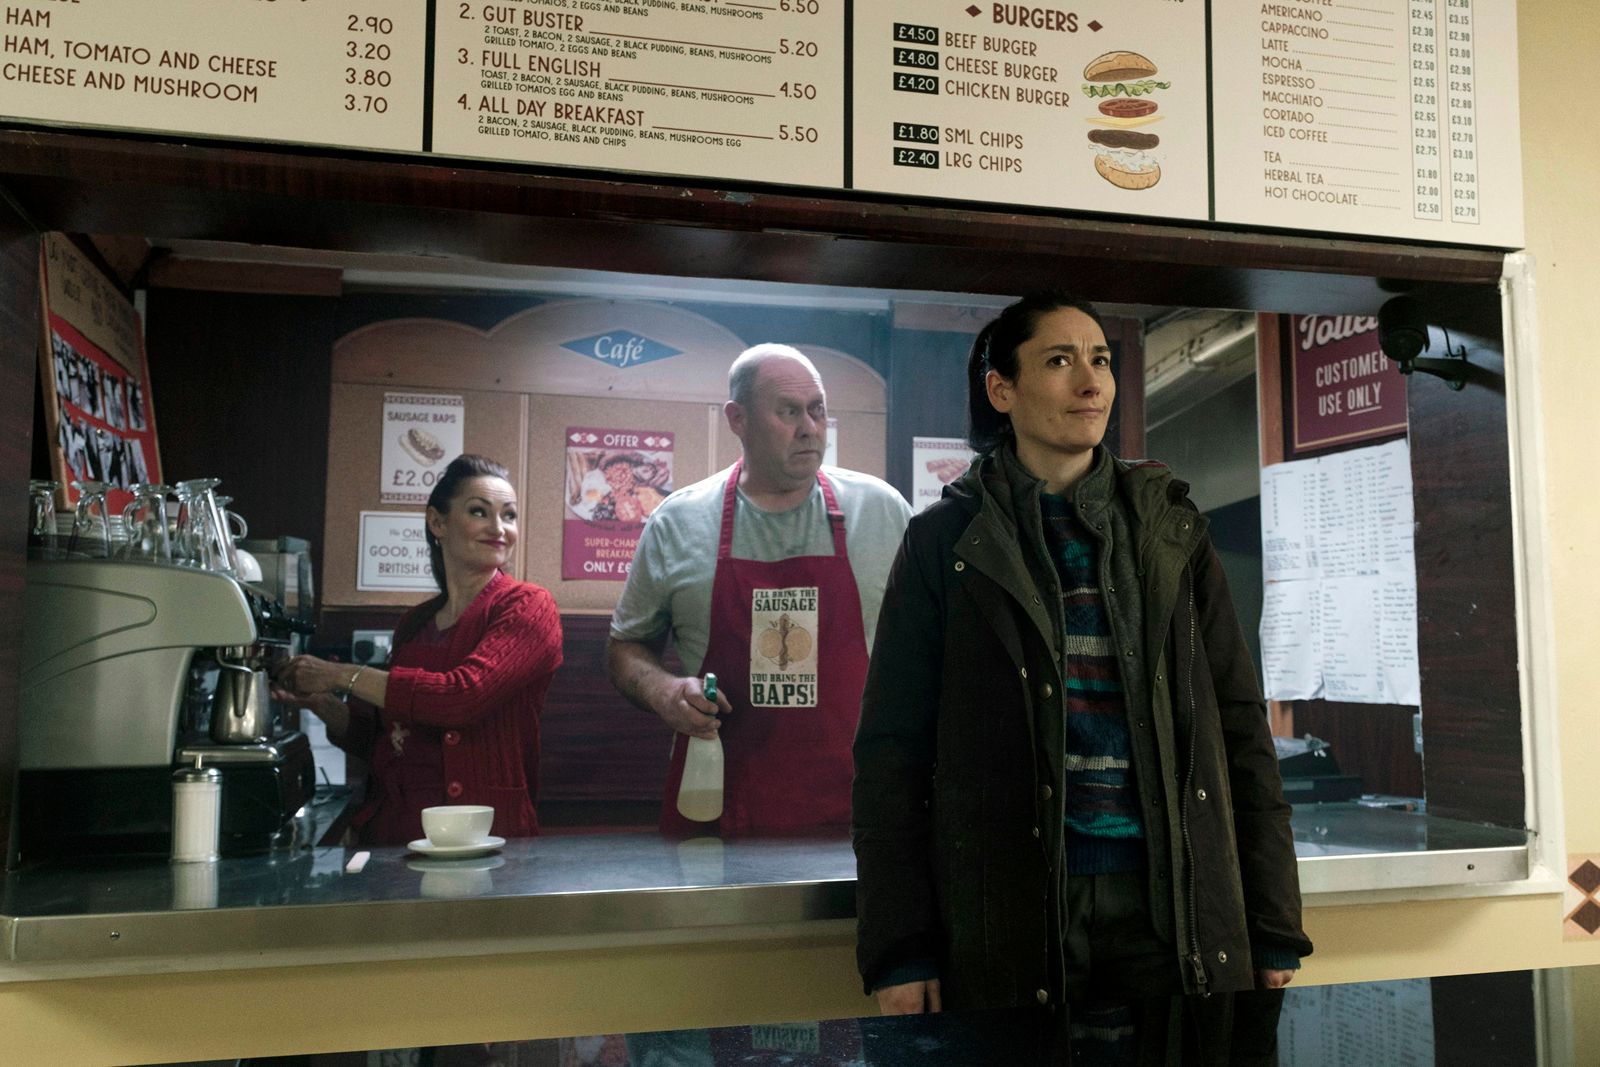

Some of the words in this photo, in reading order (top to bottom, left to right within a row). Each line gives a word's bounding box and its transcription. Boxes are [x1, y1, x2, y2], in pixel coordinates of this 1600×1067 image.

[572, 1, 577, 9] 2
[581, 3, 601, 12] EGGS
[604, 5, 621, 14] AND
[623, 7, 649, 17] BEANS
[681, 2, 708, 14] BEANS,
[710, 7, 763, 20] MUSHROOMS
[780, 0, 819, 15] 6.50
[1261, 4, 1323, 22] AMERICANO
[6, 7, 51, 28] HAM
[347, 14, 393, 35] 2.90
[460, 3, 475, 20] 2.
[483, 5, 516, 24] GUT
[523, 10, 583, 32] BUSTER
[992, 3, 1079, 33] BURGERS
[1261, 21, 1329, 39] CAPPACCINO
[484, 25, 490, 34] 2
[492, 26, 521, 37] TOAST,
[524, 30, 529, 38] 2
[532, 31, 564, 42] BACON,
[567, 35, 573, 43] 2
[575, 35, 613, 47] SAUSAGE,
[615, 40, 621, 48] 2
[623, 40, 648, 50] BLACK
[651, 43, 687, 56] PUDDING,
[690, 48, 717, 59] BEANS,
[719, 51, 772, 64] MUSHROOMS
[484, 36, 516, 46] GRILLED
[518, 39, 557, 52] TOMATO,
[559, 44, 565, 52] 2
[567, 44, 589, 54] EGGS
[591, 46, 609, 56] AND
[611, 49, 637, 59] BEANS
[779, 39, 818, 57] 5.20
[898, 26, 936, 42] £4.50
[945, 32, 977, 50] BEEF
[983, 36, 1038, 57] BURGER
[1262, 39, 1289, 52] LATTE
[4, 35, 55, 59] HAM,
[64, 40, 150, 65] TOMATO
[159, 51, 200, 70] AND
[208, 56, 278, 78] CHEESE
[346, 41, 391, 61] 3.20
[458, 48, 474, 65] 3.
[482, 50, 521, 70] FULL
[529, 55, 601, 78] ENGLISH
[898, 50, 937, 67] £4.80
[945, 55, 999, 76] CHEESE
[1004, 62, 1059, 83] BURGER
[1262, 56, 1302, 70] MOCHA
[3, 63, 76, 87] CHEESE
[84, 71, 125, 90] AND
[134, 76, 258, 103] MUSHROOM
[345, 68, 392, 88] 3.80
[1263, 73, 1315, 89] ESPRESSO
[481, 70, 510, 81] TOAST,
[512, 73, 518, 82] 2
[521, 74, 553, 86] BACON,
[556, 78, 561, 86] 2
[564, 79, 602, 91] SAUSAGE,
[604, 82, 630, 92] BLACK
[632, 85, 668, 97] PUDDING,
[671, 89, 699, 101] BEANS,
[701, 92, 754, 105] MUSHROOMS
[481, 80, 513, 91] GRILLED
[515, 83, 557, 96] TOMATOS
[559, 88, 575, 97] EGG
[578, 90, 595, 100] AND
[597, 92, 624, 102] BEANS
[779, 82, 817, 100] 4.50
[898, 75, 936, 92] £4.20
[945, 80, 1010, 101] CHICKEN
[1016, 87, 1070, 108] BURGER
[344, 94, 388, 114] 3.70
[1263, 91, 1323, 107] MACCHIATO
[1414, 94, 1436, 105] £2.20
[457, 93, 472, 111] 4.
[478, 95, 510, 115] ALL
[517, 99, 547, 118] DAY
[554, 102, 645, 127] BREAKFAST
[1263, 108, 1314, 123] CORTADO
[478, 115, 483, 124] 2
[486, 116, 520, 128] BACON,
[523, 120, 528, 128] 2
[530, 120, 569, 133] SAUSAGE,
[572, 124, 597, 134] BLACK
[600, 127, 637, 139] PUDDING,
[639, 131, 667, 142] BEANS,
[670, 133, 724, 146] MUSHROOMS
[726, 138, 742, 147] EGG
[478, 126, 510, 137] GRILLED
[513, 129, 552, 141] TOMATO,
[554, 133, 581, 143] BEANS
[583, 135, 600, 145] AND
[603, 137, 627, 147] CHIPS
[779, 125, 818, 143] 5.50
[898, 125, 939, 141] £1.80
[945, 128, 974, 145] SML
[980, 130, 1024, 150] CHIPS
[1264, 126, 1285, 138] ICED
[1289, 128, 1328, 143] COFFEE
[1452, 132, 1473, 143] £2.70
[1264, 151, 1282, 163] TEA
[1415, 145, 1437, 156] £2.75
[898, 150, 936, 166] £2.40
[945, 152, 973, 169] LRG
[979, 154, 1023, 173] CHIPS
[1264, 169, 1302, 183] HERBAL
[1306, 172, 1324, 185] TEA
[1265, 186, 1288, 199] HOT
[1292, 189, 1358, 206] CHOCOLATE
[1454, 206, 1476, 217] £2.70
[593, 336, 645, 367] Café
[1316, 350, 1388, 387] CUSTOMER
[1319, 392, 1342, 416] USE
[1347, 382, 1382, 411] ONLY
[387, 412, 429, 423] SAUSAGE
[432, 414, 456, 423] BAPS
[603, 434, 639, 447] OFFER
[369, 546, 412, 559] GOOD,
[596, 549, 634, 559] BREAKFAS
[379, 563, 419, 574] BRITISH
[584, 561, 616, 573] ONLY
[772, 590, 797, 598] BRING
[800, 589, 817, 598] THE
[754, 599, 817, 611] SAUSAGE
[751, 674, 768, 682] YOU
[770, 674, 796, 682] BRING
[798, 674, 816, 682] THE
[752, 683, 815, 705] BAPS!
